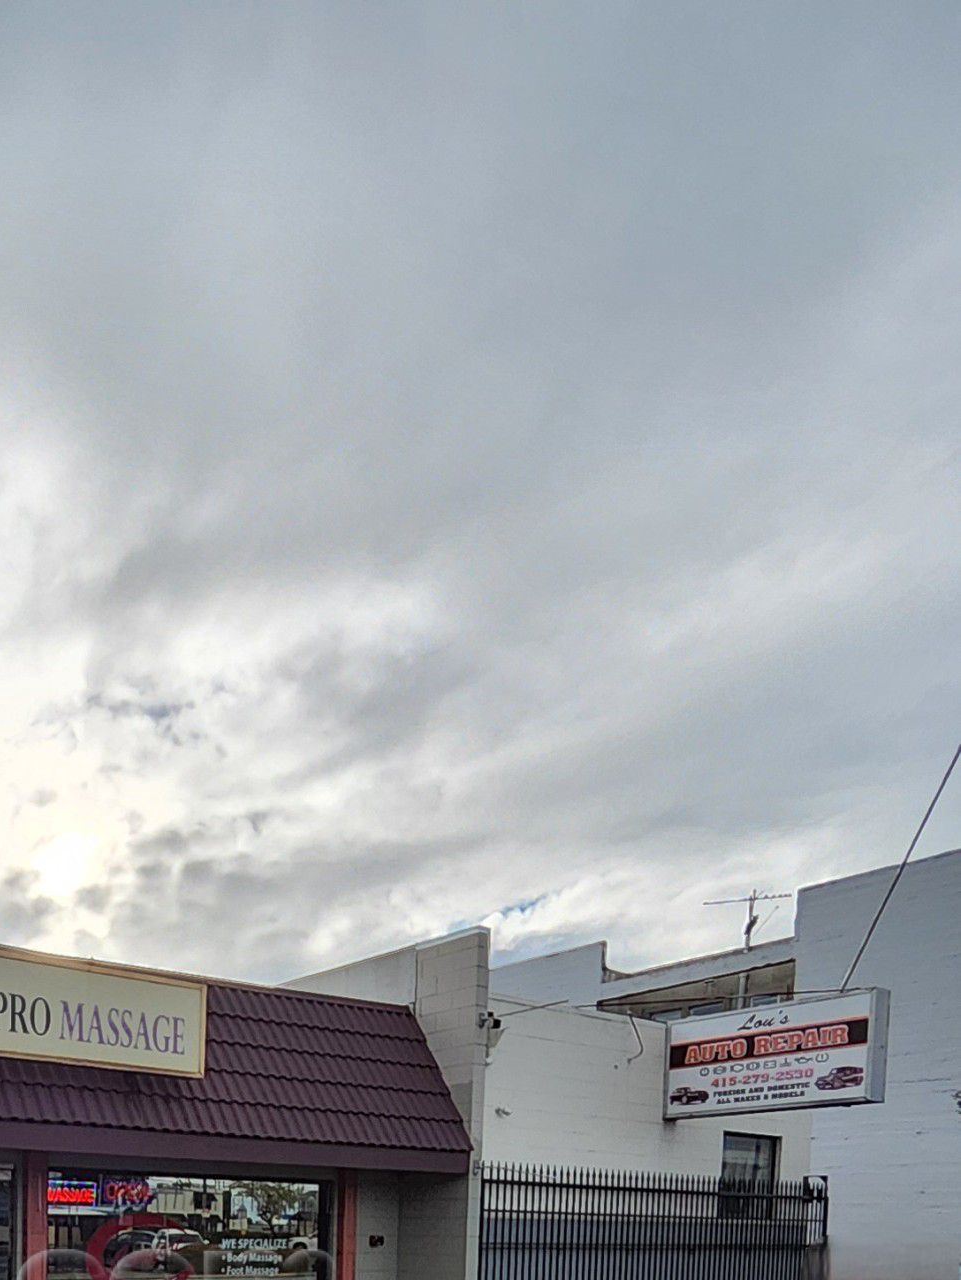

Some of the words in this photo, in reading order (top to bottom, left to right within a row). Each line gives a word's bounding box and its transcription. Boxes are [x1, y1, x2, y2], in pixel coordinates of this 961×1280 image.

[59, 999, 185, 1055] MASSAGE
[737, 1010, 789, 1030] Lou's
[685, 1038, 747, 1065] AUTO
[754, 1024, 848, 1056] REPAIR
[220, 1238, 237, 1250] WE
[238, 1238, 287, 1250] SPECIALIZE
[227, 1252, 247, 1264] Body
[248, 1253, 282, 1264] Massage
[227, 1266, 244, 1276] Foot
[246, 1266, 280, 1276] Massage
